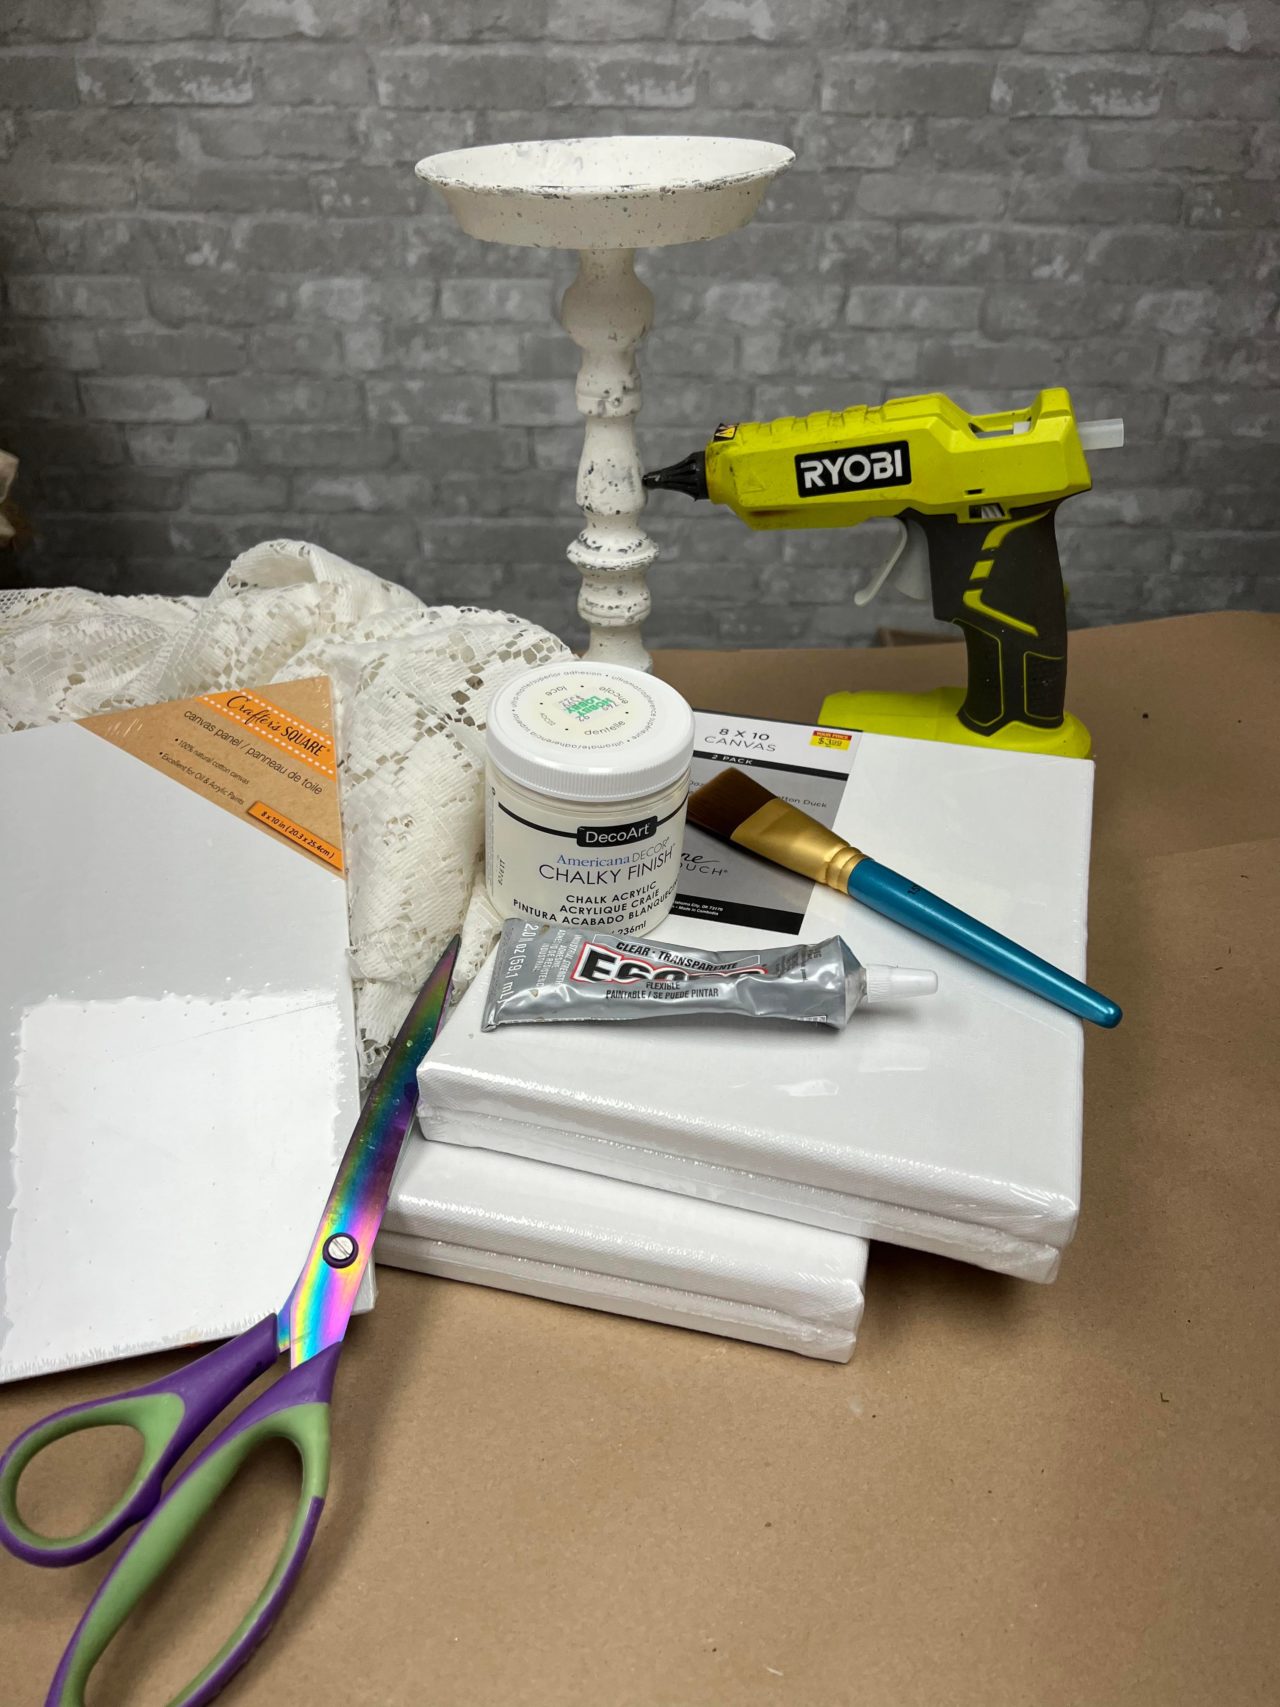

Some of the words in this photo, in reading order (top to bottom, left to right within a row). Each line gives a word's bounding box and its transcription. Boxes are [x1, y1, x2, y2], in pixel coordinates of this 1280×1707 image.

[801, 449, 903, 489] RYOBI
[545, 685, 568, 696] lace
[599, 686, 628, 704] encaje
[226, 695, 280, 731] Crafter's
[281, 726, 326, 757] SQUARE
[584, 720, 626, 736] dentelle
[704, 736, 776, 752] CANVAS
[753, 732, 770, 740] 10
[184, 710, 216, 732] canvas
[214, 728, 242, 747] panel
[245, 746, 290, 775] panneau
[288, 769, 302, 782] de
[302, 778, 322, 795] toile
[722, 756, 752, 765] PACK
[194, 748, 214, 764] natural
[212, 758, 230, 774] cotton
[209, 780, 228, 796] Acrylic
[804, 800, 826, 808] Duck
[271, 815, 278, 825] 10
[585, 824, 650, 844] DecoArt
[539, 864, 622, 884] CHALKY
[628, 848, 672, 880] FINISH
[556, 854, 630, 867] Americana
[566, 894, 607, 904] CHALK
[612, 881, 656, 903] ACRYLIC
[560, 904, 627, 914] ACRYLIQUE
[632, 889, 660, 908] CRAIE
[514, 900, 557, 922] PINTURA
[562, 914, 624, 926] ACABADO
[514, 944, 526, 954] oz
[616, 942, 650, 956] CLEAR
[658, 952, 738, 972] TRANSPARENTE
[606, 990, 646, 999] PAINTABLE
[654, 990, 663, 999] SE
[665, 990, 688, 999] PUEDE
[691, 988, 719, 998] PINTAR
[646, 982, 680, 990] FLEXIBLE
